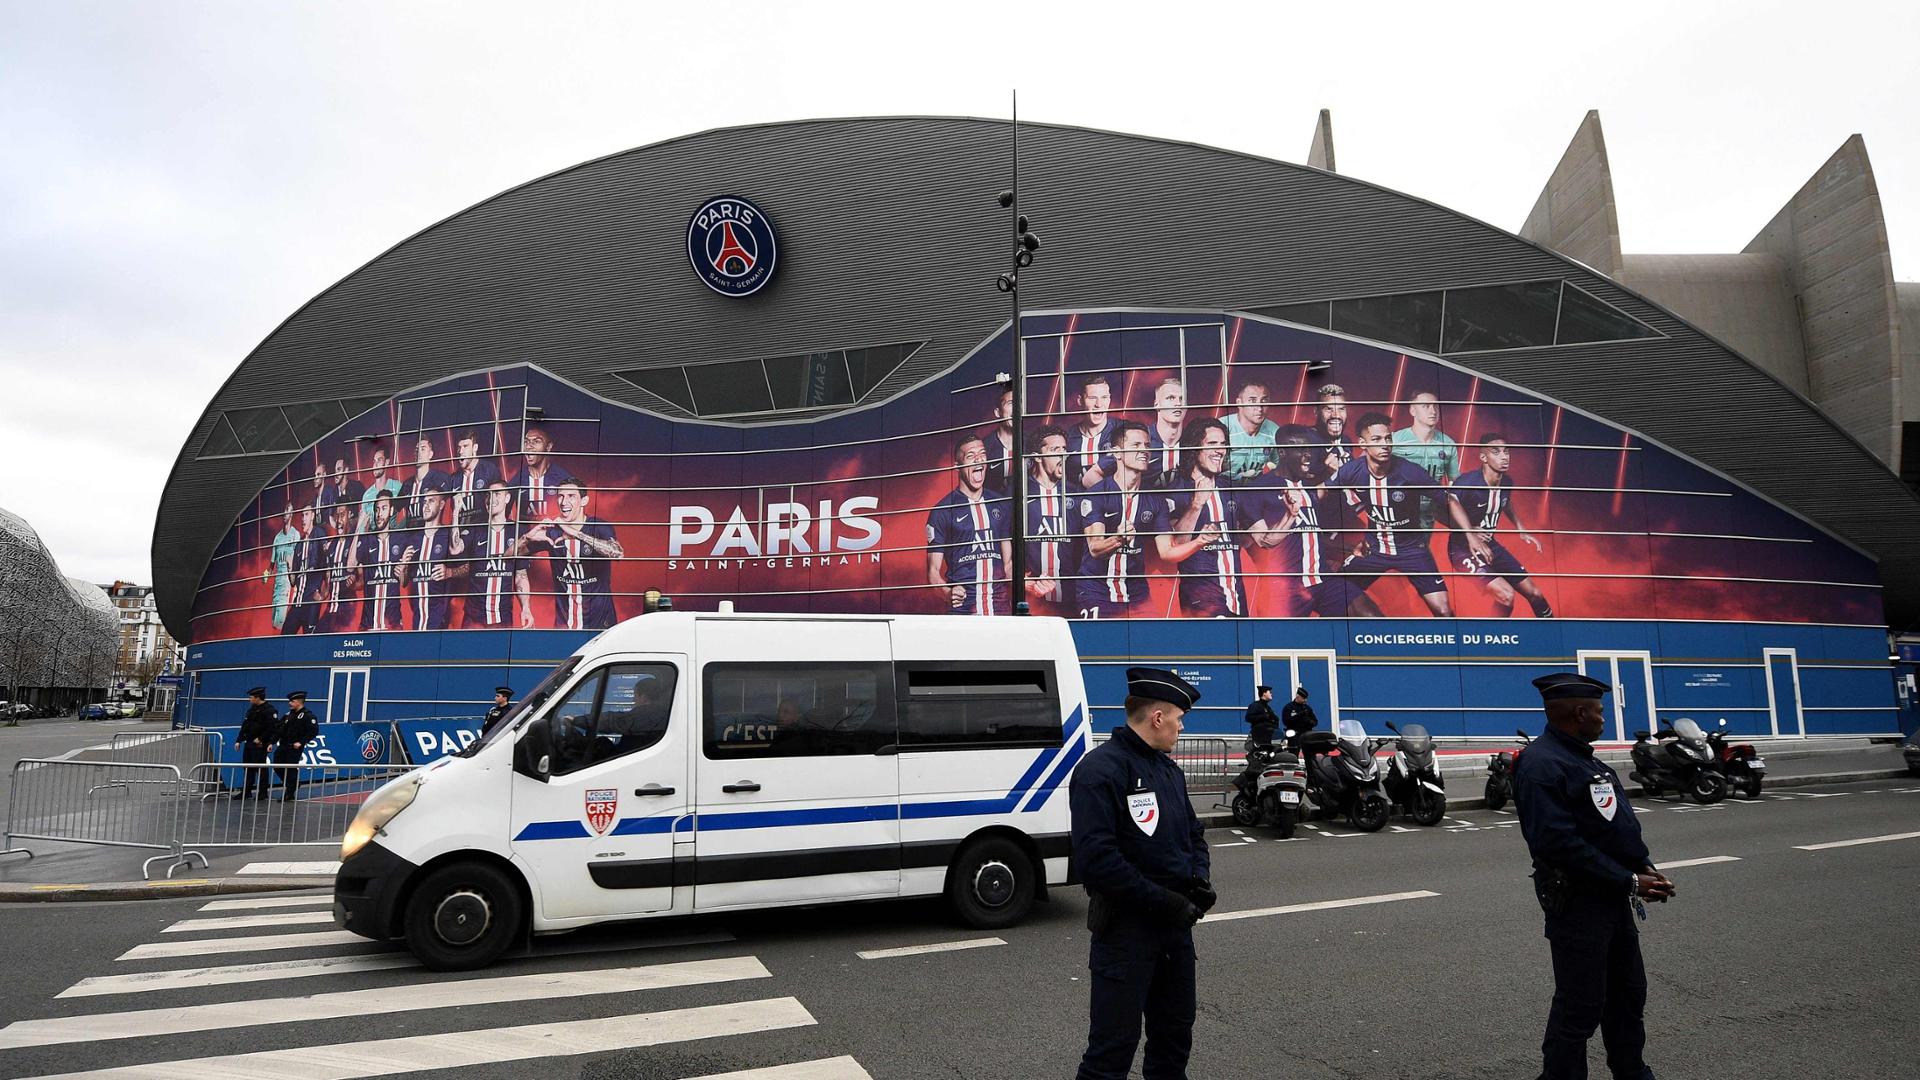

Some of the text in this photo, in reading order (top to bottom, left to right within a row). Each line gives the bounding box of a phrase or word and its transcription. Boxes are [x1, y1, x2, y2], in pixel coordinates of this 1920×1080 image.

[697, 204, 754, 231] PARIS
[709, 266, 765, 289] SAINT-GERMAIN
[668, 496, 882, 557] PARIS
[668, 553, 881, 570] SAINT-GERMAIN
[1355, 634, 1519, 645] CONCIERGERIE DU PARC
[333, 650, 372, 658] DES PRINCES
[587, 803, 614, 815] CRS
